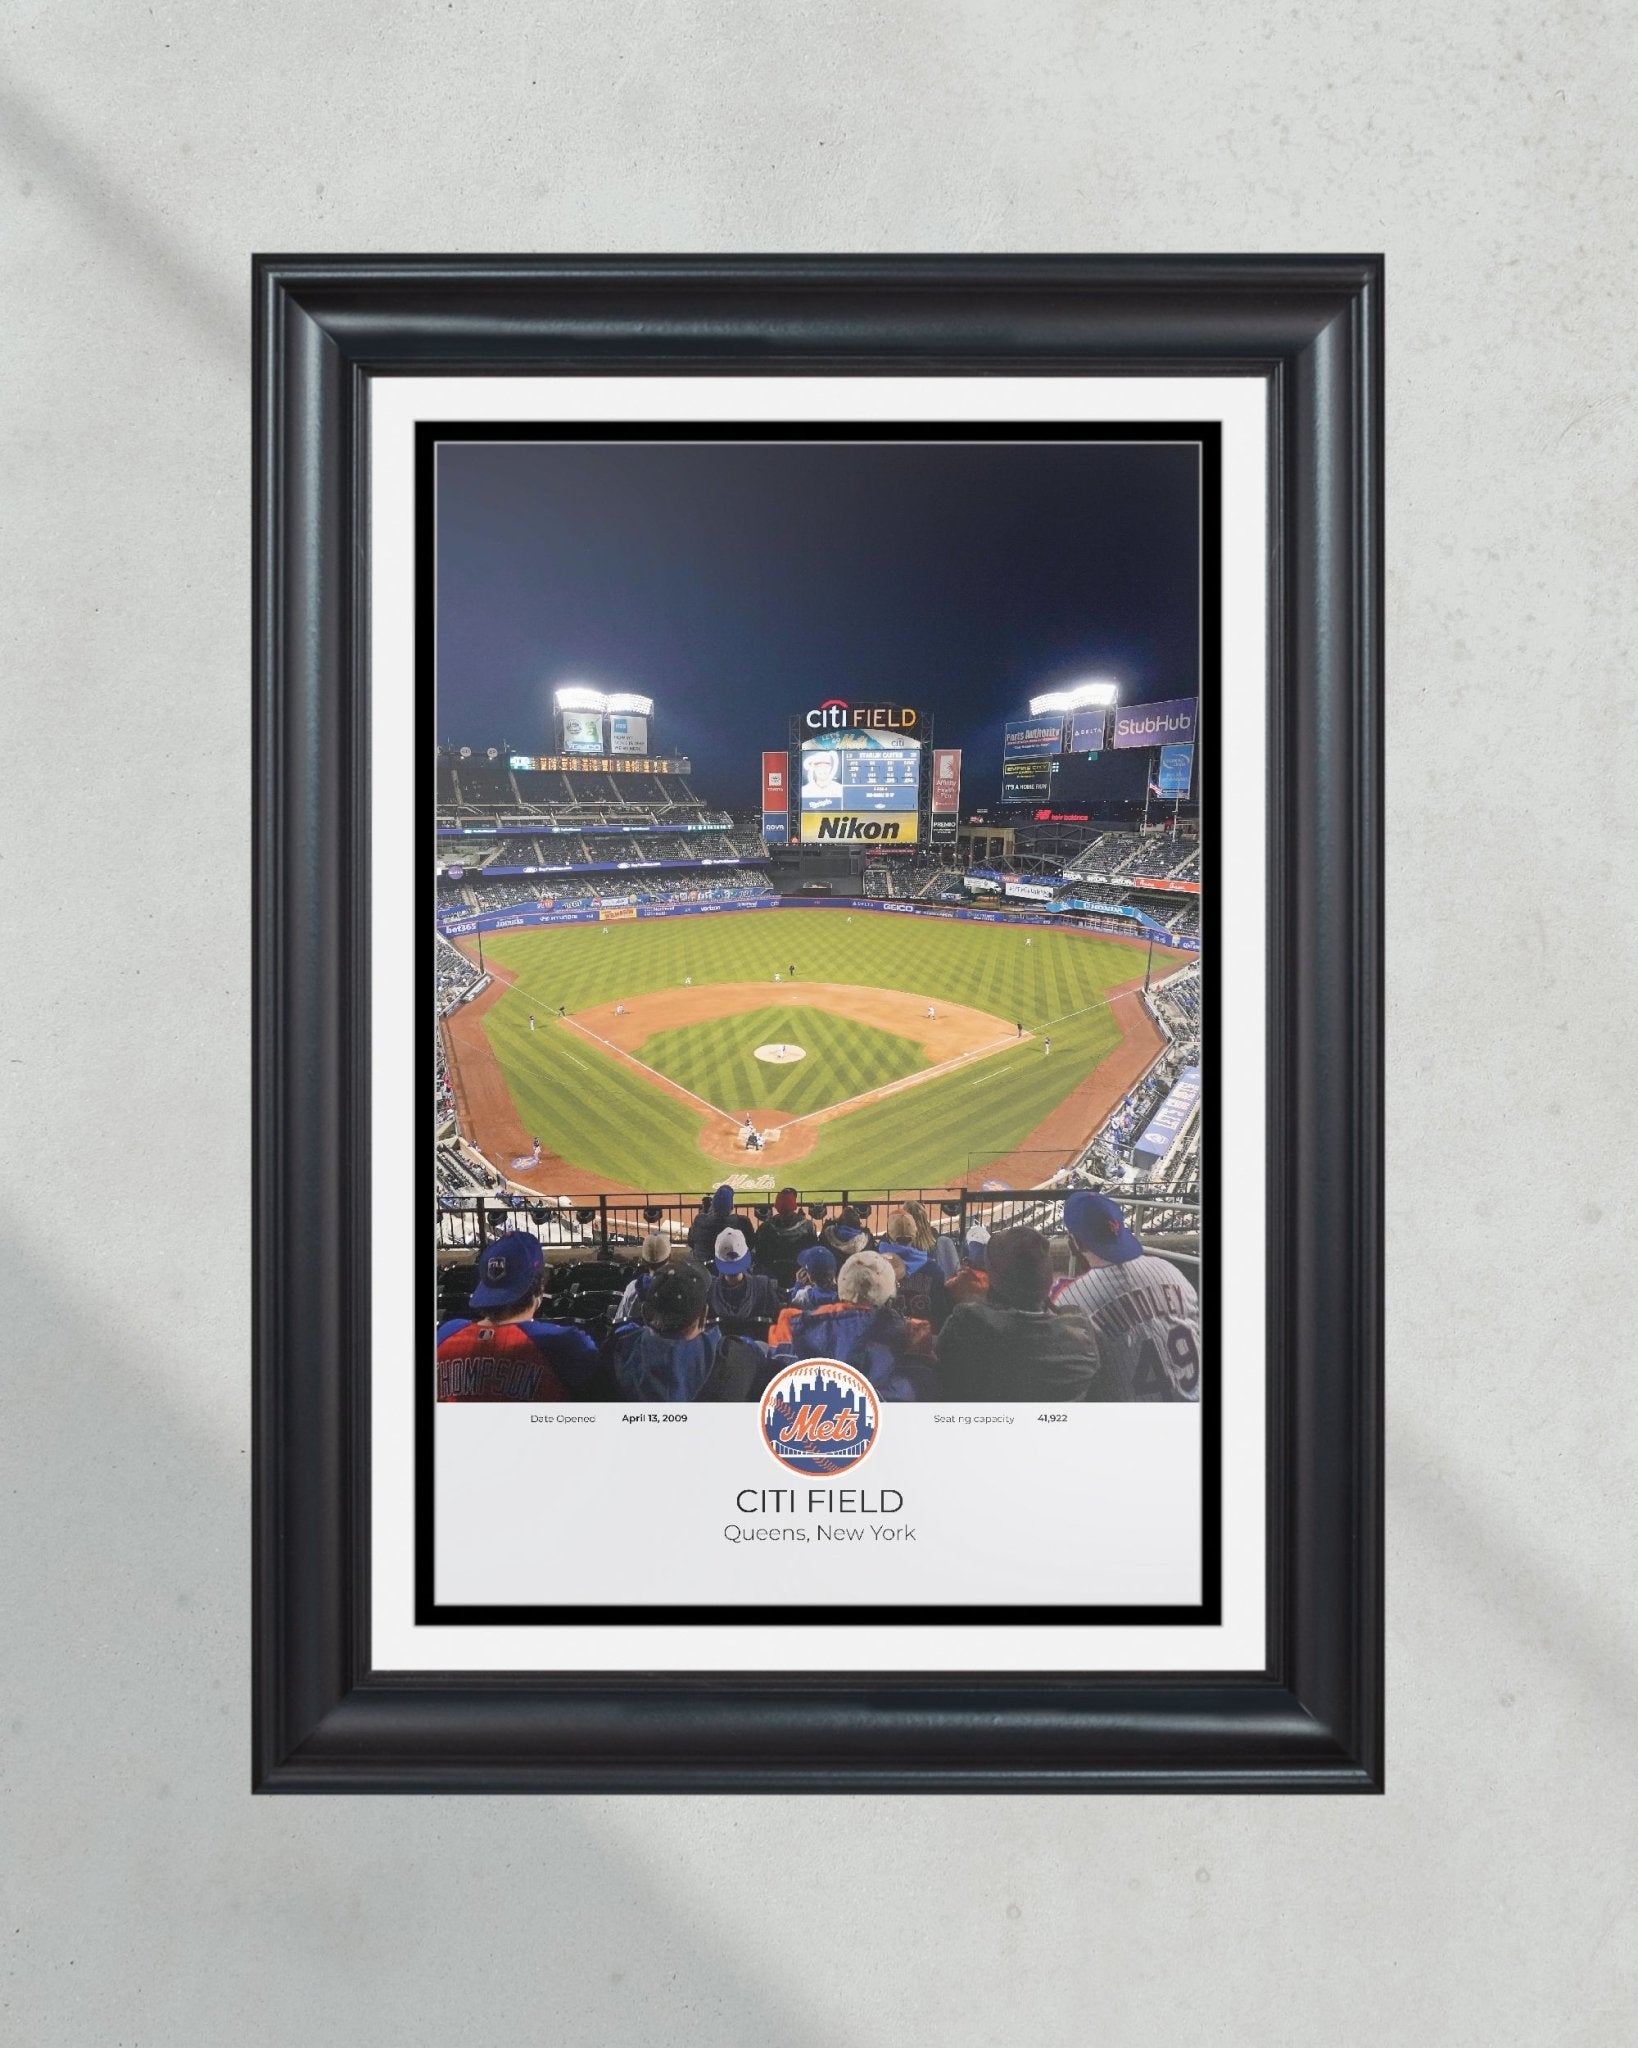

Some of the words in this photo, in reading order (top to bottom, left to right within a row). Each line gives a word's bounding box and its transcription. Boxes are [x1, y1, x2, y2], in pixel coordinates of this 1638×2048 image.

[853, 708, 917, 728] FIELD
[1117, 713, 1191, 736] StubHub
[1006, 732, 1024, 741] Parts
[1025, 728, 1060, 740] Authority
[818, 816, 899, 839] Nikon
[883, 903, 914, 912] GEICO
[446, 922, 477, 934] bet365
[437, 1357, 544, 1401] HOMPSON
[530, 1414, 554, 1423] Date
[556, 1414, 596, 1425] Opened
[622, 1413, 646, 1425] April
[648, 1414, 660, 1424] 13,
[662, 1414, 688, 1423] 2009
[780, 1404, 859, 1442] Mets
[933, 1414, 972, 1425] Seatng
[973, 1414, 1015, 1425] capacity
[1037, 1413, 1068, 1424] 41,922
[737, 1488, 795, 1514] CITI
[808, 1488, 904, 1514] FIELD
[723, 1523, 811, 1544] Queens,
[817, 1523, 865, 1542] New
[870, 1523, 917, 1542] York
